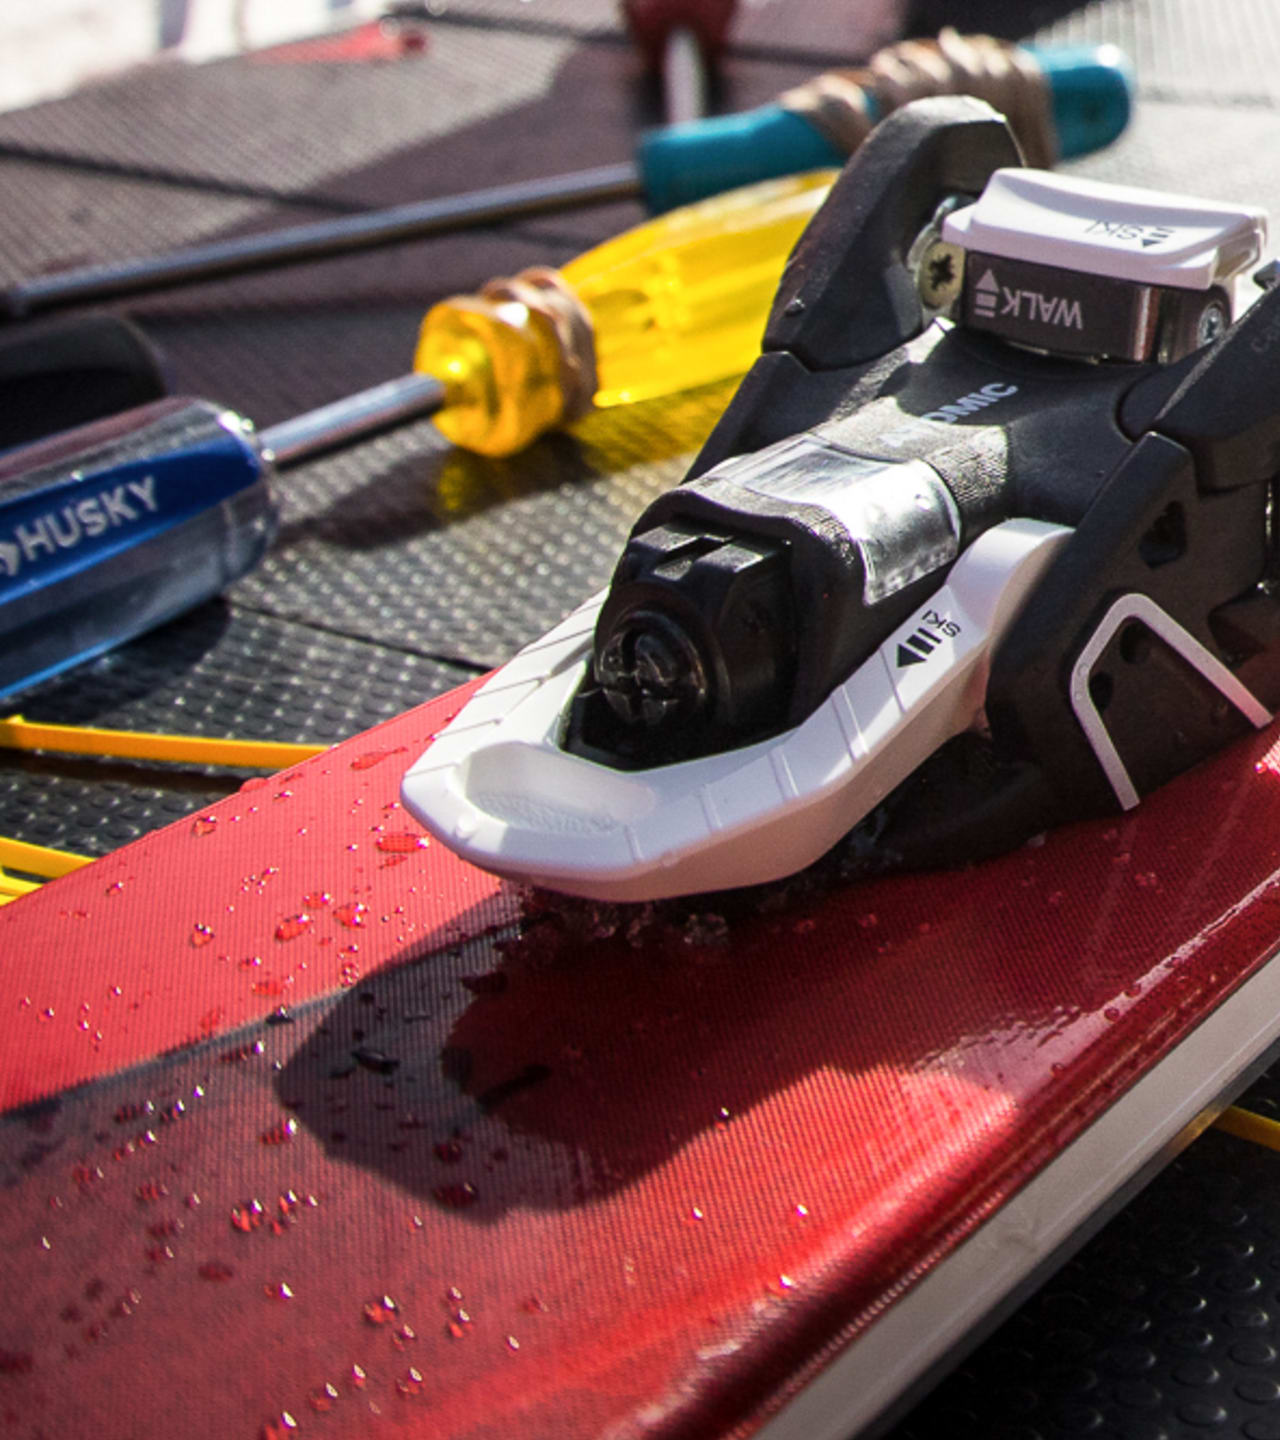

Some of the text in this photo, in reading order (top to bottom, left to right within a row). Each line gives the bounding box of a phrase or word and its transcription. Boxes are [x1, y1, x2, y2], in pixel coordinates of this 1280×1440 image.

[1085, 220, 1143, 240] SKI
[1003, 286, 1083, 331] WALK
[14, 474, 158, 561] HUSKY
[922, 610, 961, 637] SKI
